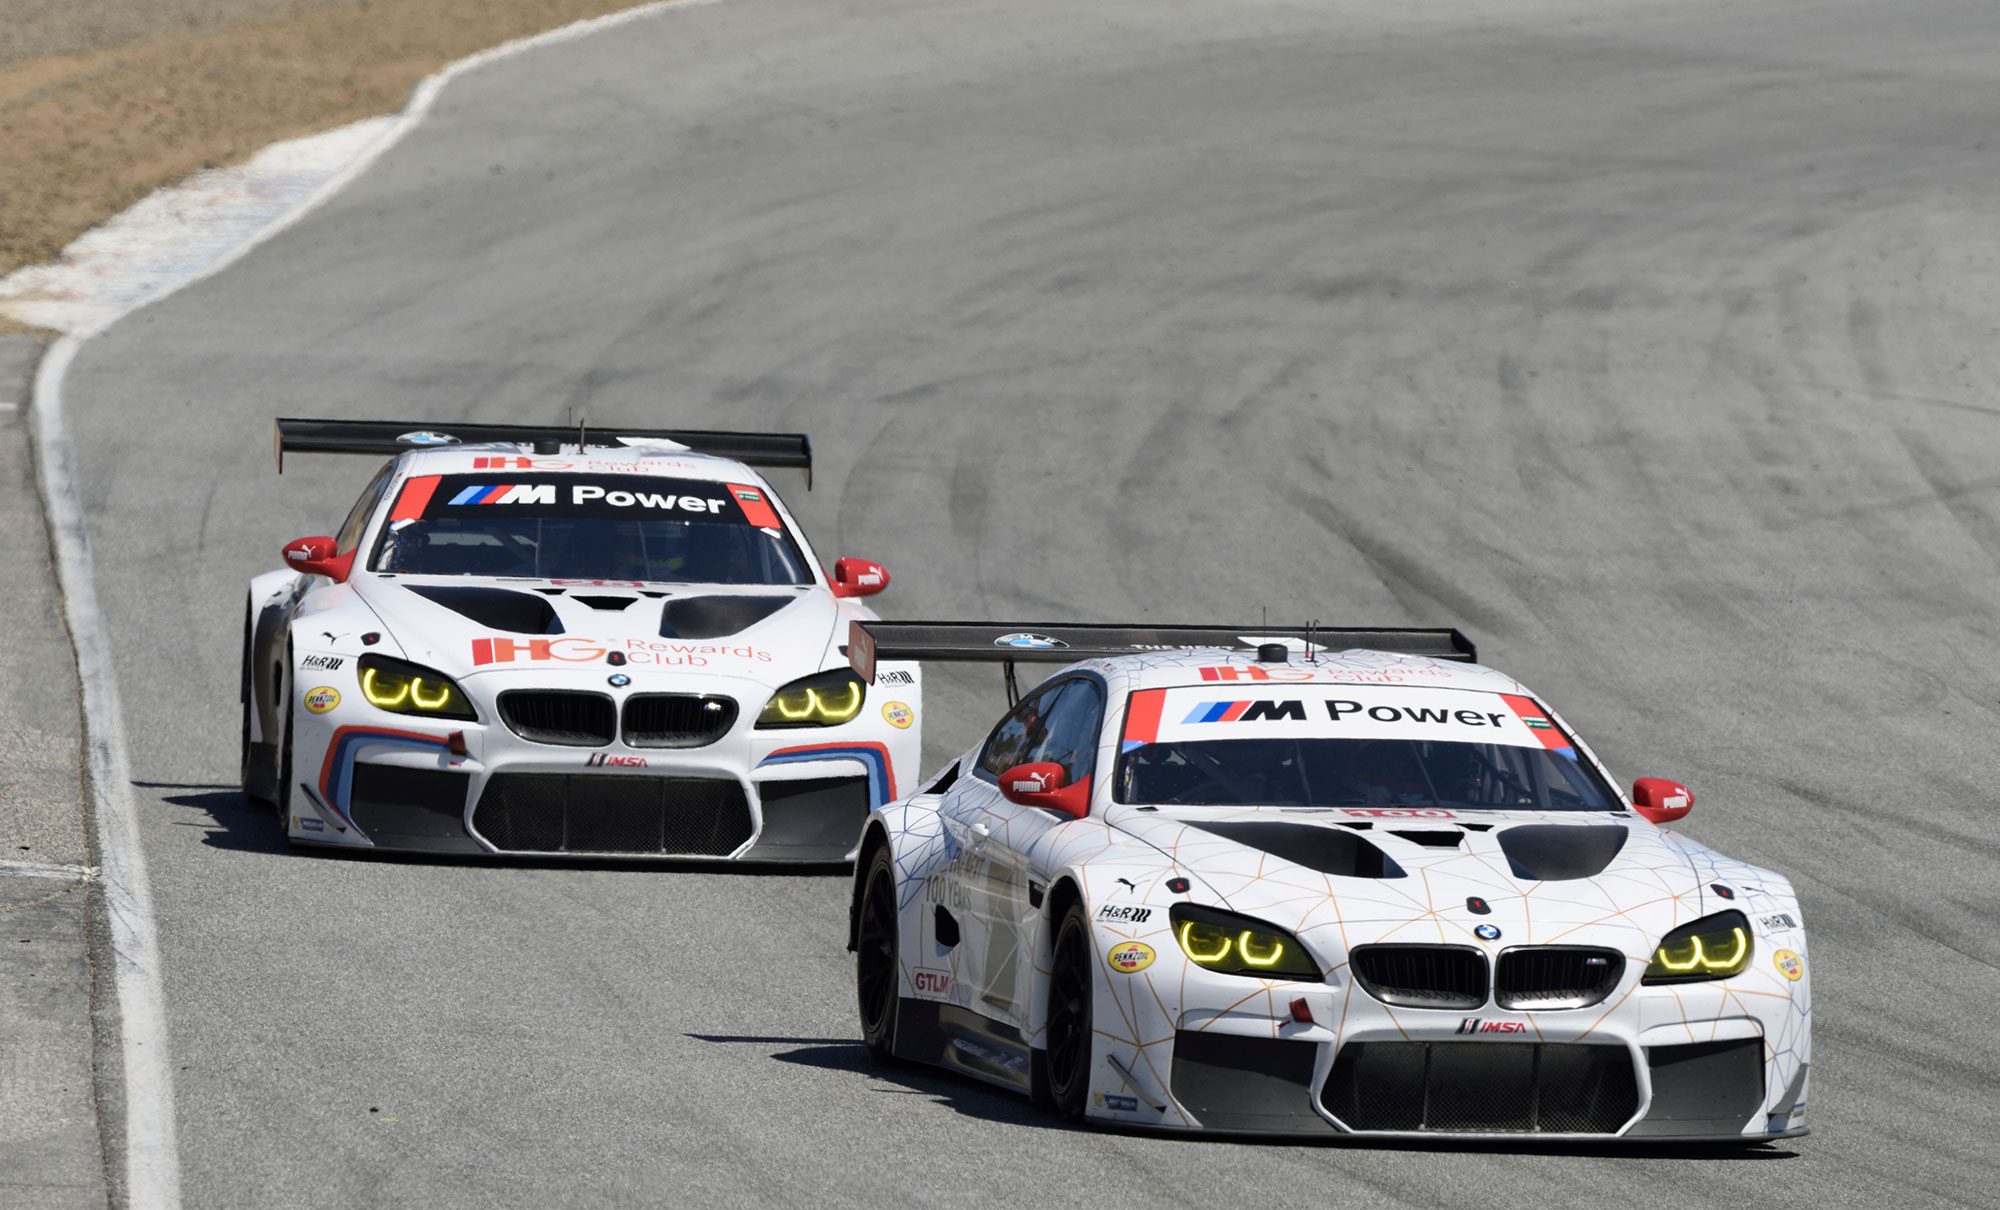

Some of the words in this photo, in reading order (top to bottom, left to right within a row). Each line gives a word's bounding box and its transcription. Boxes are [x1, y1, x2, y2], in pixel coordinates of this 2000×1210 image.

[495, 484, 556, 505] M
[572, 485, 726, 514] Power
[471, 637, 607, 667] IHG
[626, 638, 773, 663] Rewards
[627, 652, 708, 667] Club
[1238, 699, 1307, 721] M
[1324, 699, 1507, 728] Power
[1012, 780, 1041, 792] PUMA
[1479, 1022, 1527, 1034] IMSA
